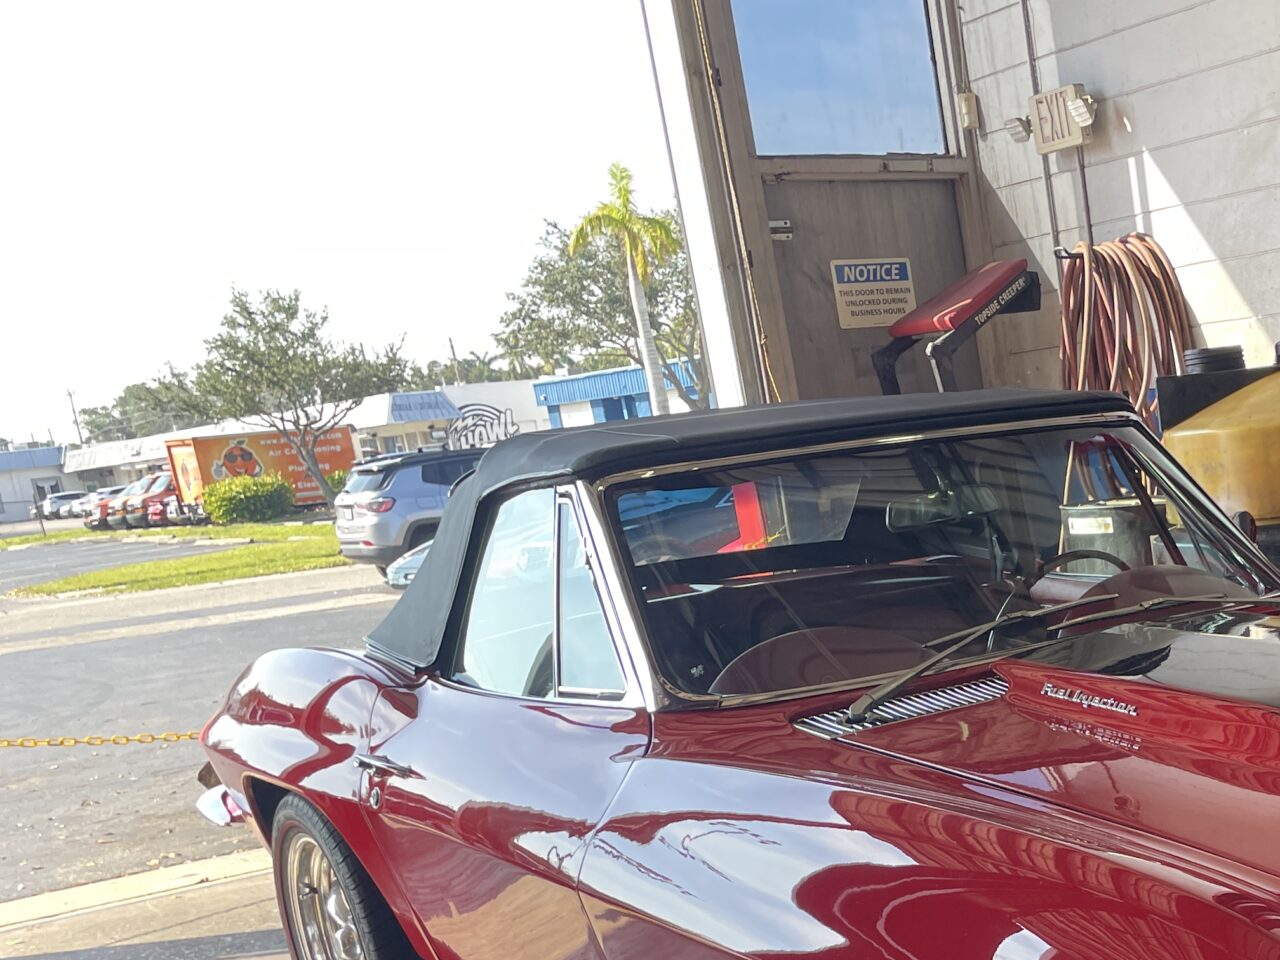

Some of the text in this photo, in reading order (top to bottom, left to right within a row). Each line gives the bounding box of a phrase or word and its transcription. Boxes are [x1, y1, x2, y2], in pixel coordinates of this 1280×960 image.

[1036, 90, 1072, 144] EXIT
[844, 264, 900, 282] NOTICE
[855, 288, 875, 296] DOOR
[876, 288, 885, 296] TO
[886, 287, 911, 295] REMAIN
[845, 297, 908, 307] UNLOCKED DURING
[850, 307, 906, 317] BUSINESS HOURS
[974, 300, 1001, 325] TOPSIDE
[284, 444, 342, 455] Coioning
[288, 463, 330, 473] Plung
[1041, 683, 1137, 716] Fuel Injection
